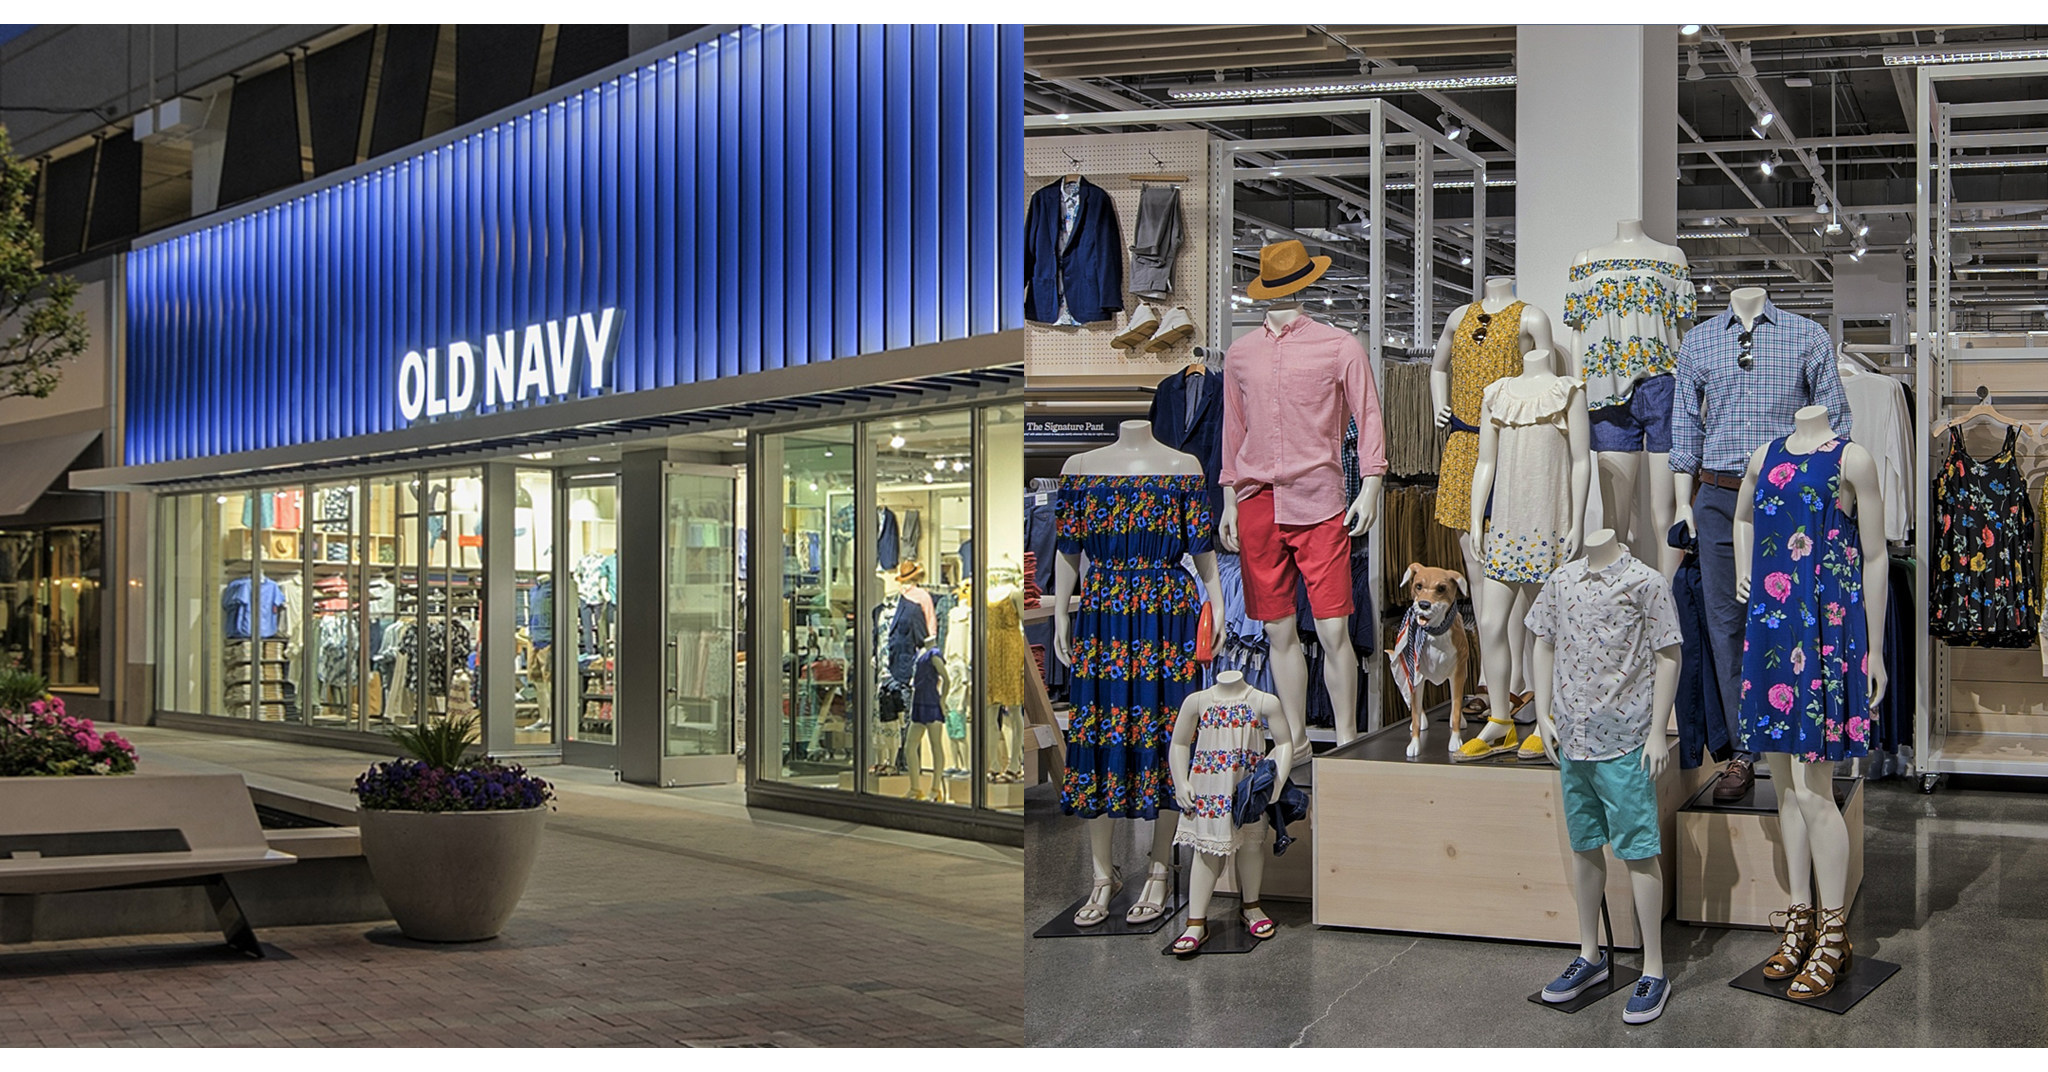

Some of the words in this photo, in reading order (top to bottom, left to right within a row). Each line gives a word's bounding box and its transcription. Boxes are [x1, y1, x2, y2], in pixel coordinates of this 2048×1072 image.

[398, 340, 476, 421] OLD
[485, 306, 616, 407] NAVY
[1026, 422, 1043, 431] The
[1044, 421, 1084, 432] Signature
[1085, 422, 1105, 431] Pant
